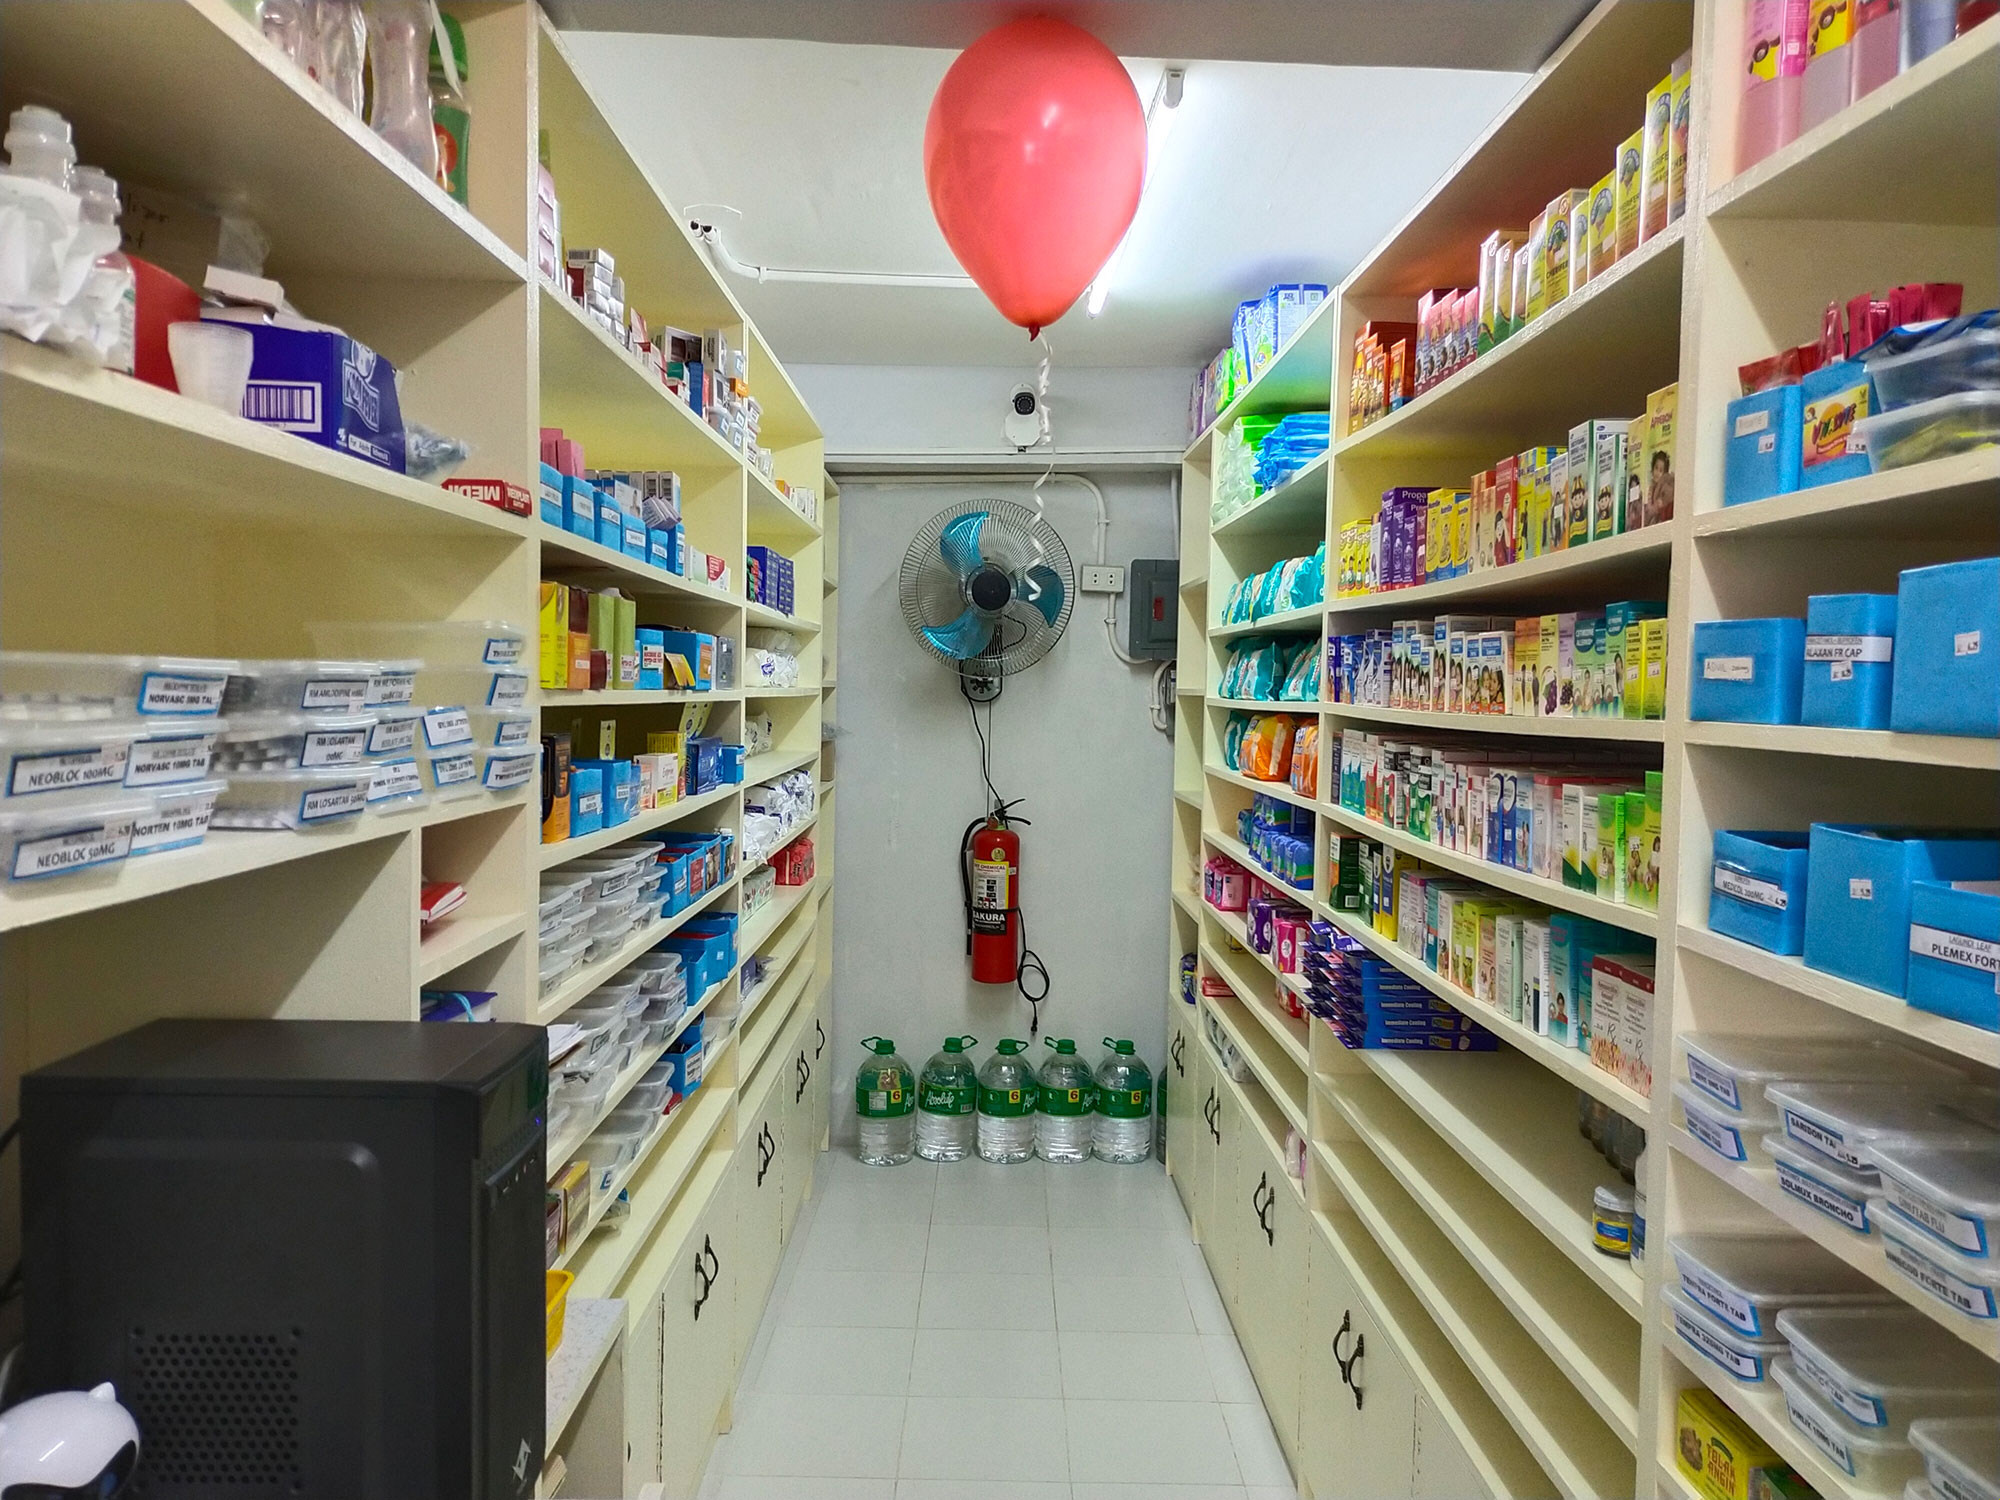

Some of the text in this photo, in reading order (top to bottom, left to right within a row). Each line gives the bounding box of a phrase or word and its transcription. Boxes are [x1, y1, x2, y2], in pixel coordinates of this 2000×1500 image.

[1844, 648, 1863, 658] CAP
[148, 694, 185, 705] NORVASC
[135, 761, 171, 773] NORVASC
[192, 757, 206, 769] TAB
[29, 768, 81, 787] NEOBLOC
[133, 820, 170, 837] NORTEN
[37, 849, 86, 869] NEOBLOC
[1932, 943, 1972, 964] PLEMEX
[891, 1090, 901, 1101] 6
[924, 1089, 955, 1109] Absolute
[1010, 1090, 1019, 1101] 6
[1069, 1090, 1079, 1100] 6
[1132, 1092, 1141, 1102] 6
[1790, 1117, 1823, 1142] SARIDON
[1780, 1176, 1854, 1222] SOLMUX BRONCHO
[1950, 1290, 1972, 1309] TAB
[1730, 1307, 1747, 1322] TAB
[1725, 1348, 1741, 1367] TAB
[1707, 1461, 1736, 1497] ANGIN
